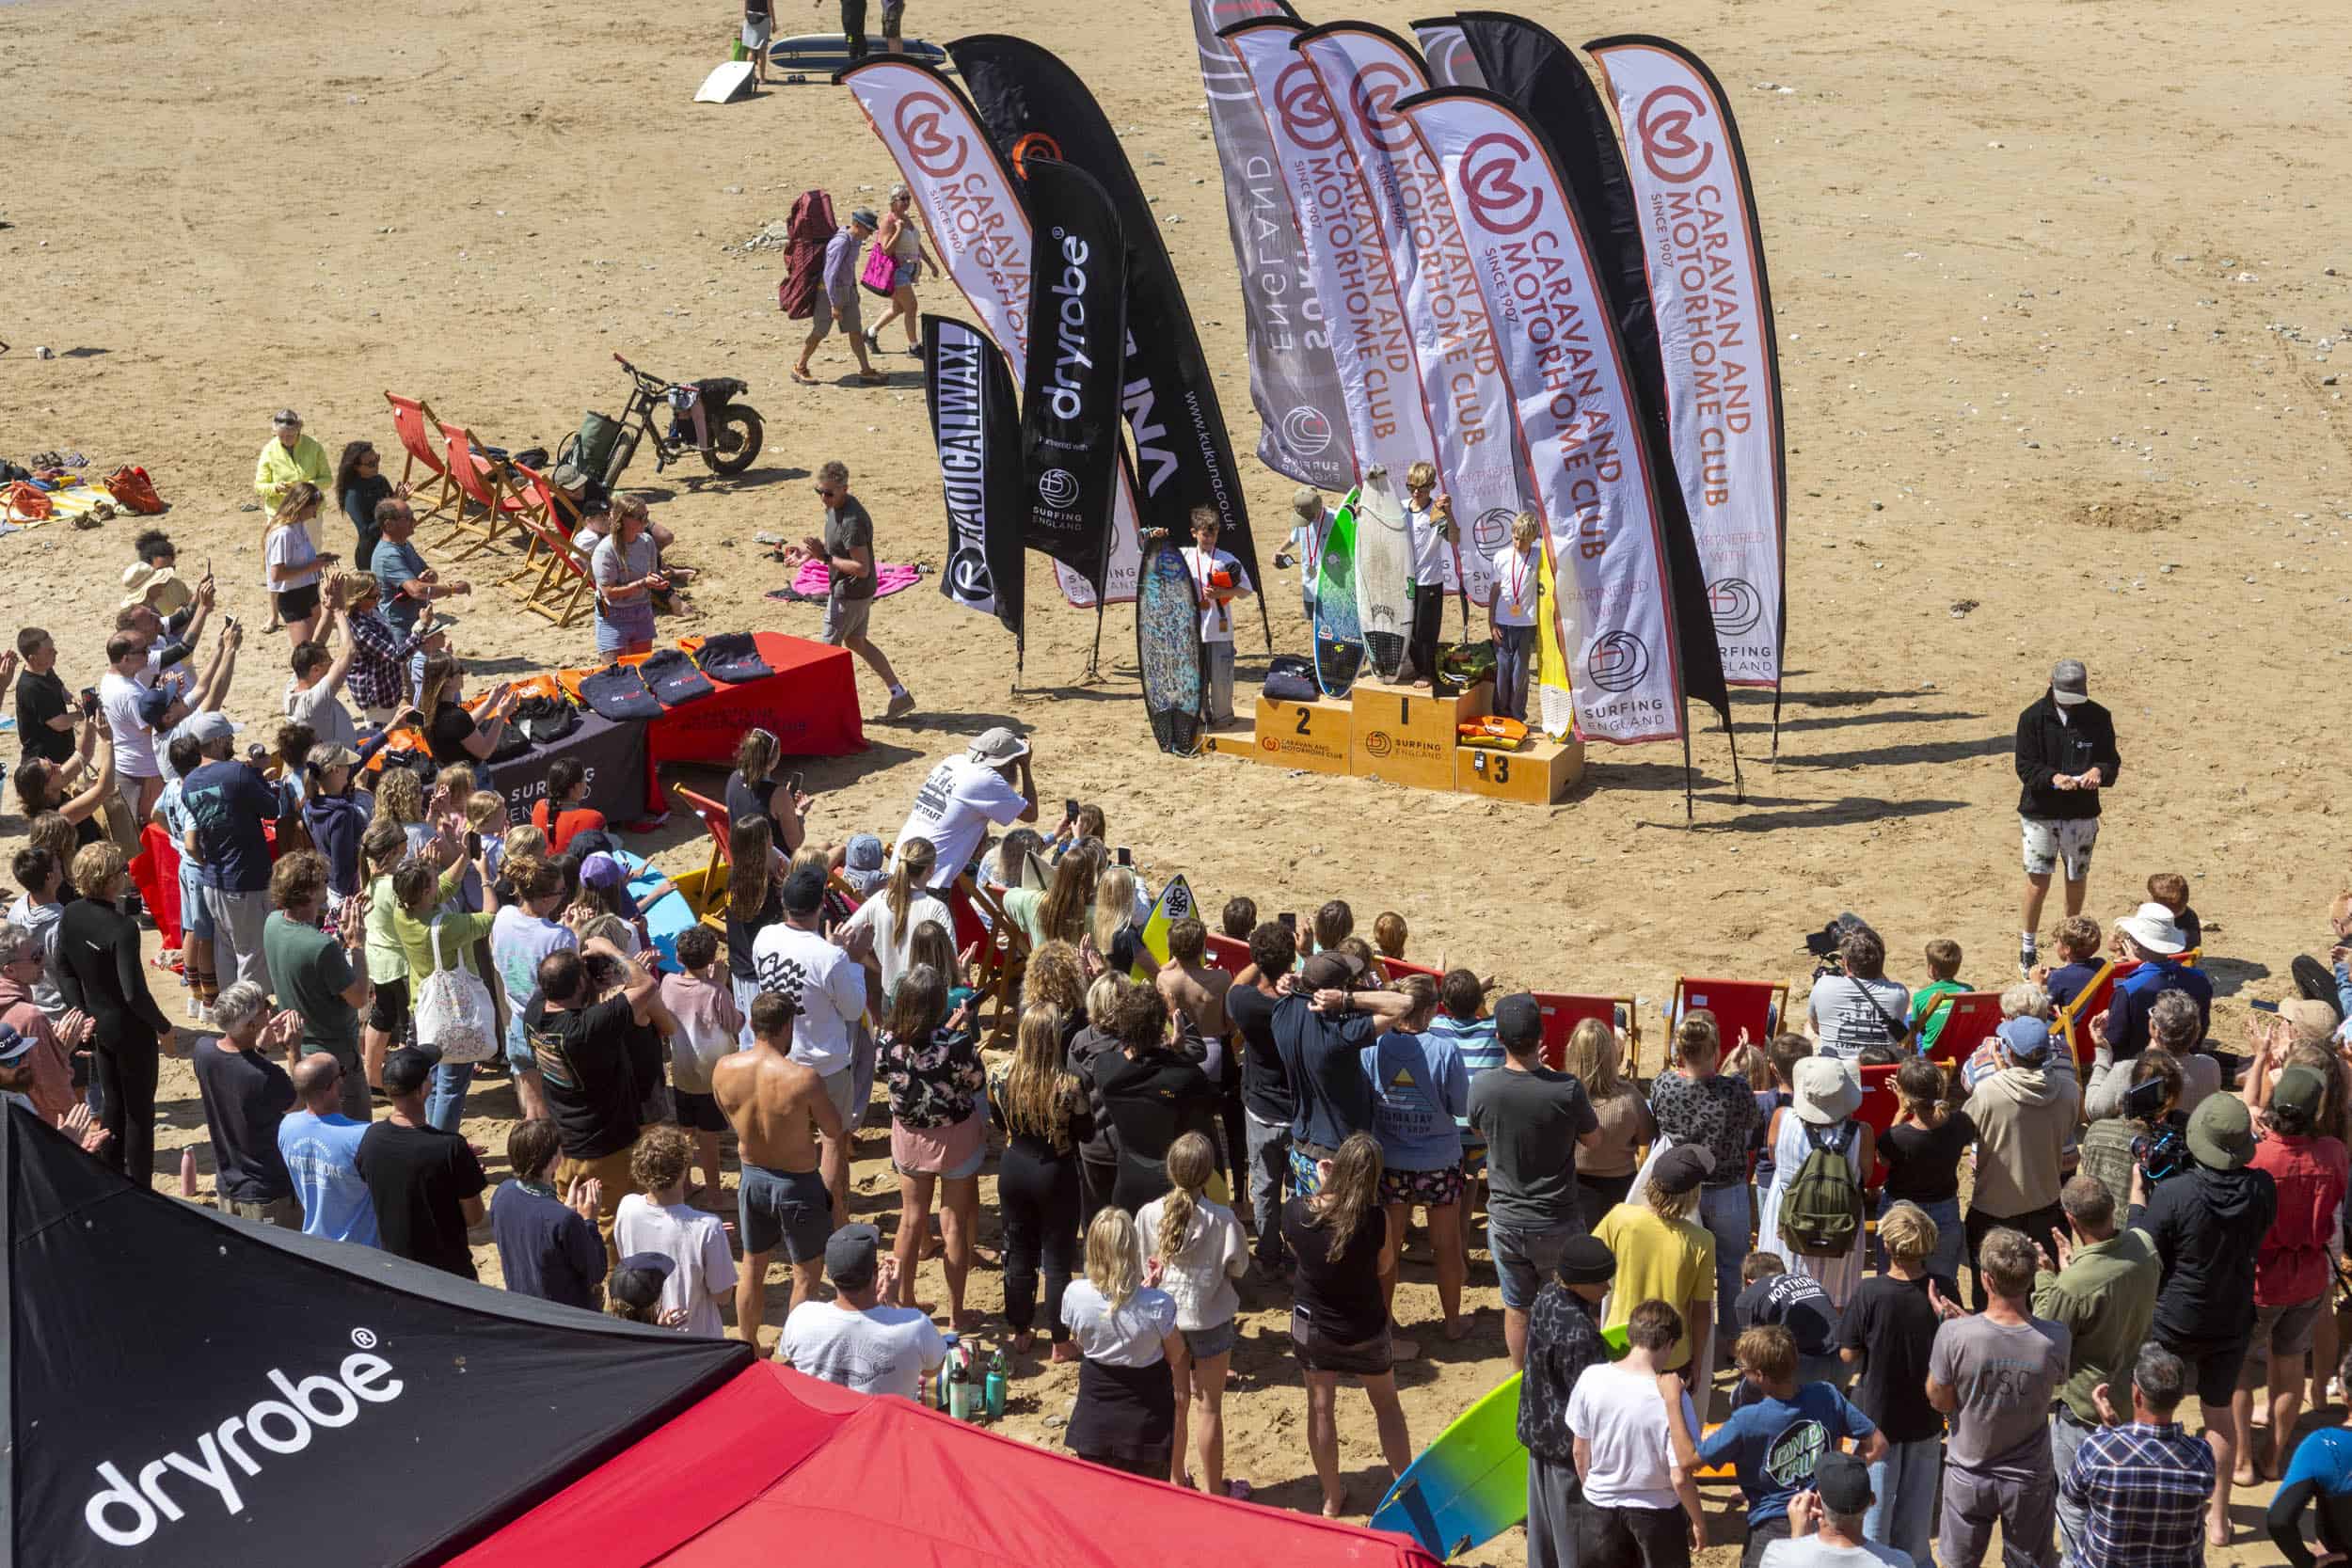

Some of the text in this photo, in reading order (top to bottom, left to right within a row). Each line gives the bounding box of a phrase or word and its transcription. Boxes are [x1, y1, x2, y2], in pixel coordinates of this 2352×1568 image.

[1295, 160, 1323, 230] SINCE 1907
[1376, 164, 1397, 203] SINCE
[947, 223, 965, 256] 1907
[1650, 193, 1674, 269] SINCE 1907
[1308, 157, 1396, 439] MOTORHOME CLUB
[1485, 247, 1519, 324] SINCE 1907
[1389, 158, 1486, 447] MOTORHOME CLUB
[1694, 184, 1752, 436] CARAVAN AND
[1375, 308, 1409, 373] AND
[1460, 309, 1498, 376] AND
[1531, 230, 1623, 483] CARAVAN AND
[1665, 191, 1729, 508] MOTORHOME CLUB
[1500, 241, 1606, 561] MOTORHOME CLUB
[1184, 390, 1236, 531] www.kukuna.co.uk
[1032, 516, 1083, 531] ENGLAND
[1033, 506, 1082, 522] SURFING
[1697, 531, 1765, 547] ARTNERED
[1718, 646, 1771, 657] RFING
[1295, 706, 1311, 736] 2
[1584, 698, 1664, 720] SURFING
[1587, 713, 1665, 732] ENGLAND
[1206, 737, 1218, 752] 4
[1395, 738, 1441, 752] SURFING
[511, 767, 596, 800] SURG
[1494, 755, 1509, 784] 3
[921, 806, 943, 821] STAFF
[1980, 1369, 2031, 1397] CSC
